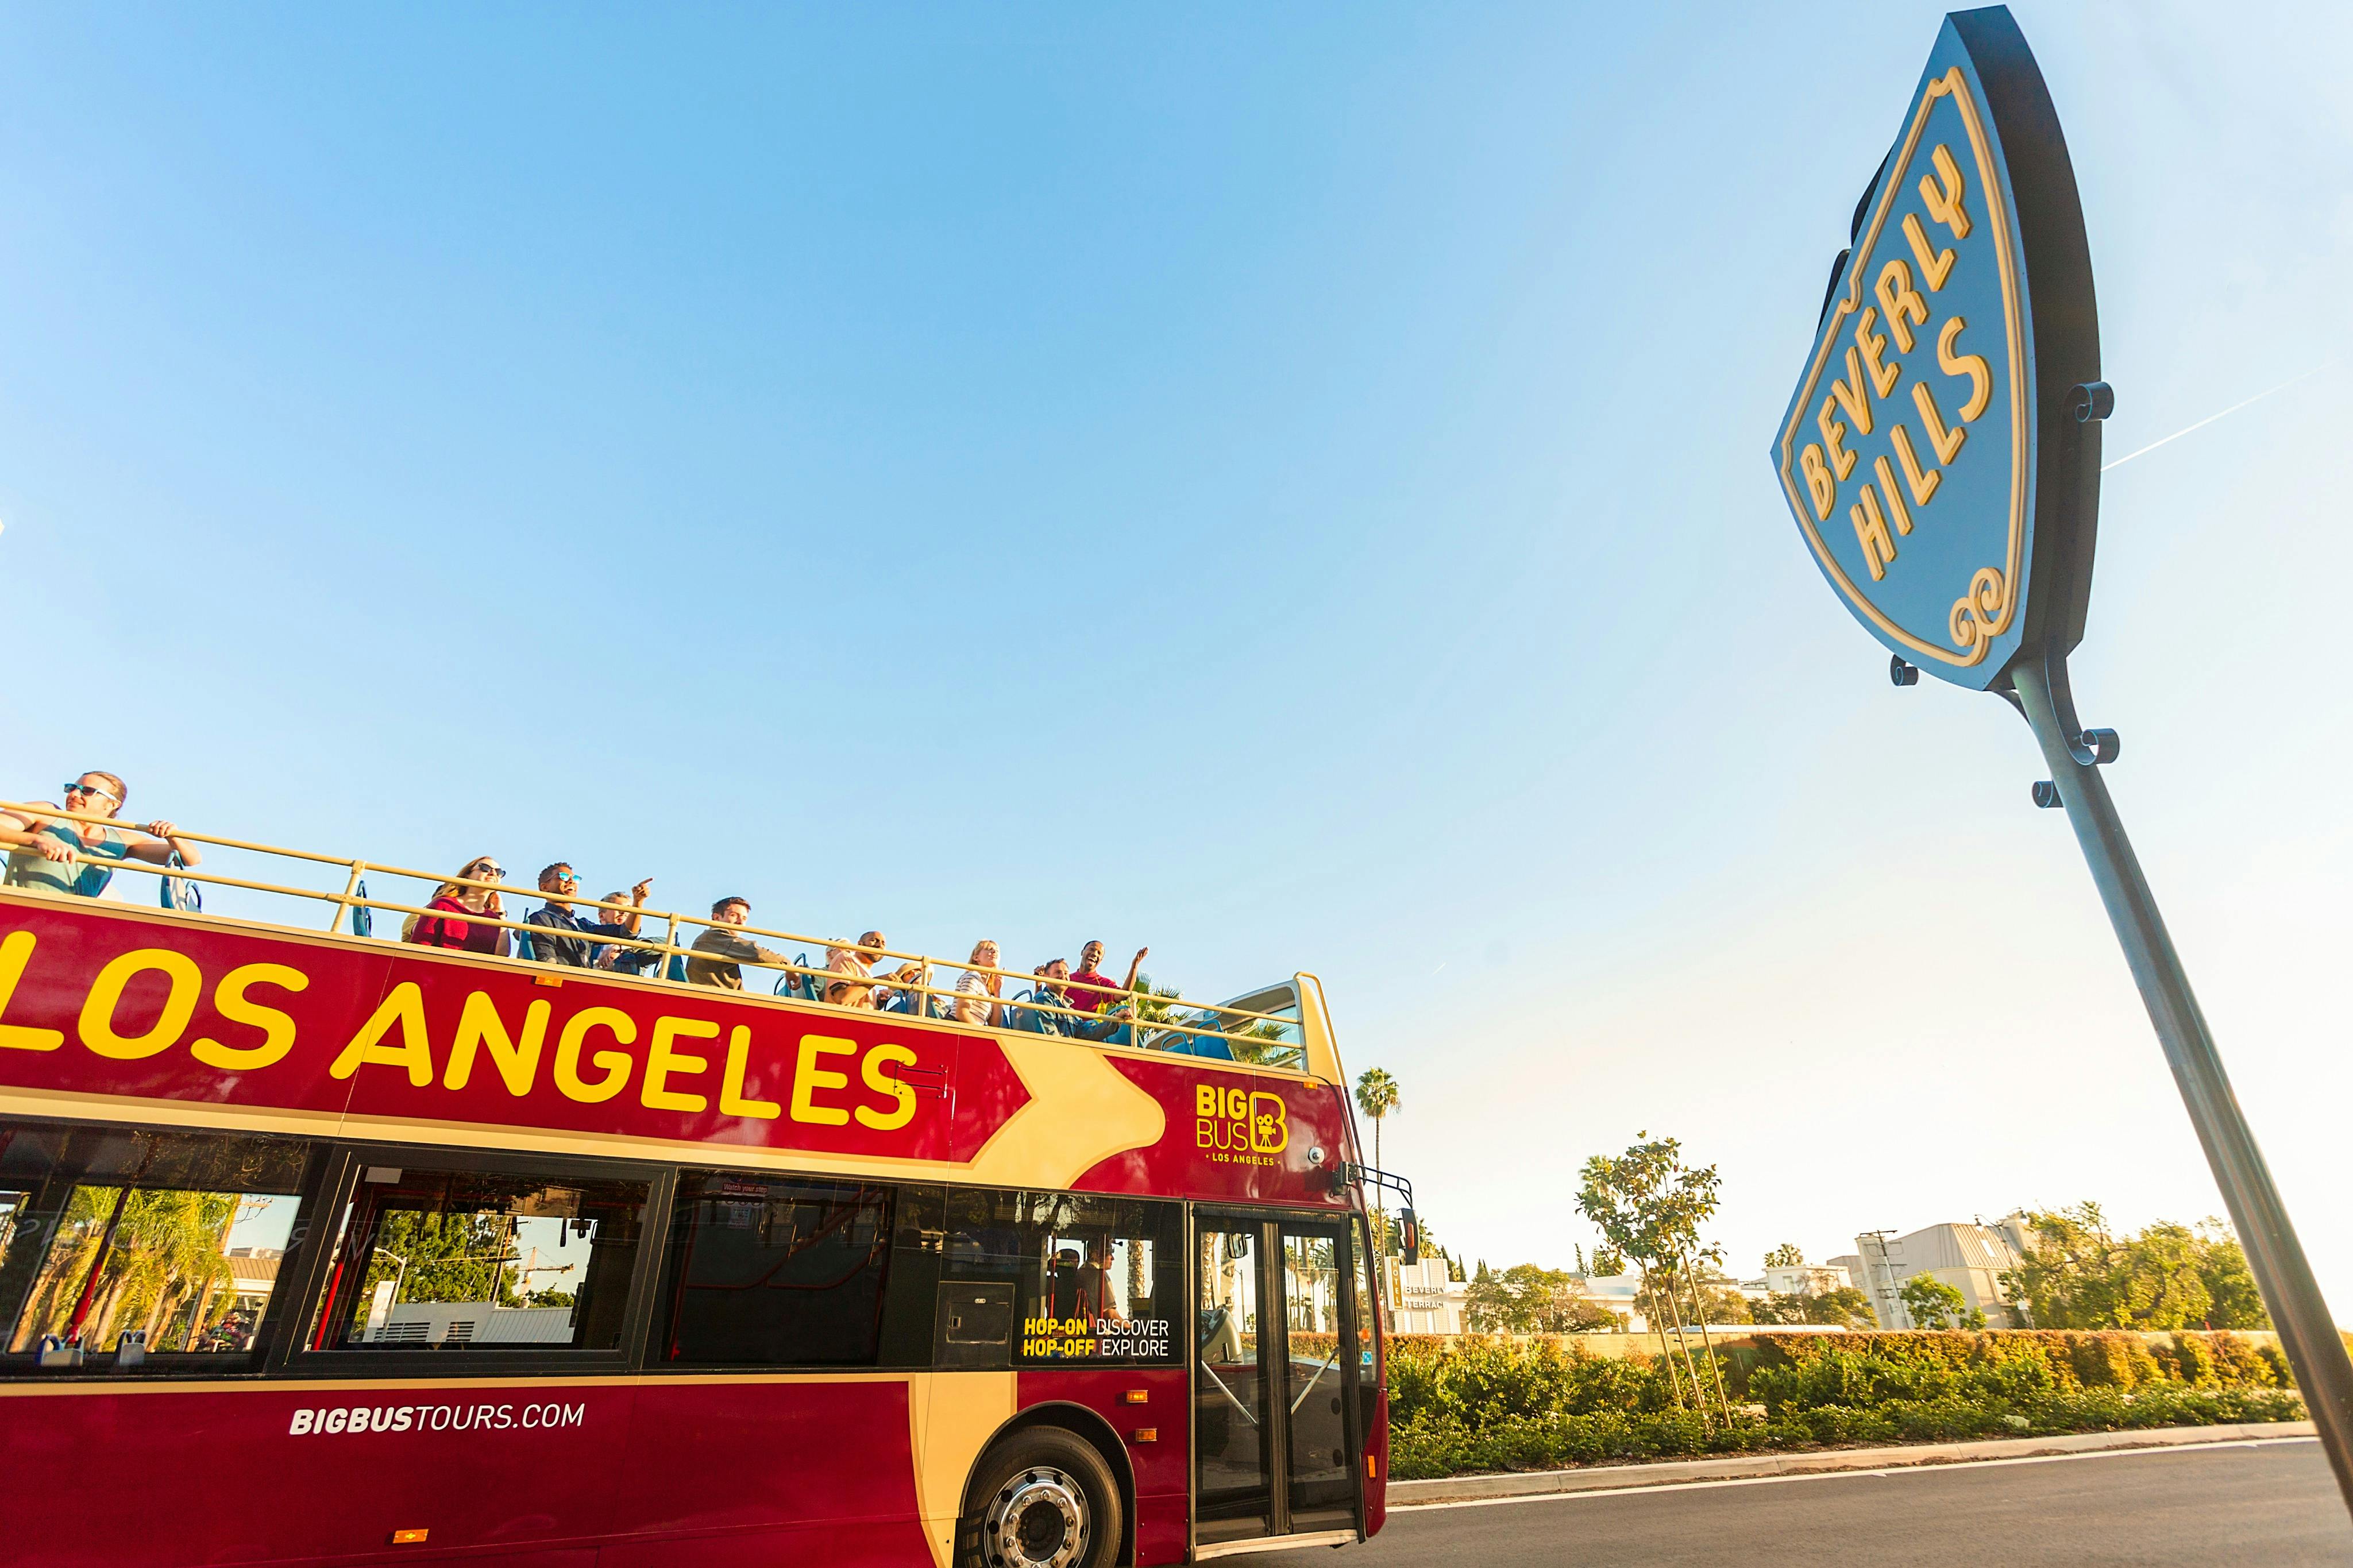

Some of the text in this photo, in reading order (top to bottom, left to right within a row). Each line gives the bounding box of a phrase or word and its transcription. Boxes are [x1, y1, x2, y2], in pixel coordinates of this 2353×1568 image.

[1800, 143, 1974, 521] BEVERLY
[1850, 316, 1993, 581] HILLS
[0, 930, 917, 1130] LOS ANGELES
[1197, 1084, 1247, 1120] BIG
[1197, 1118, 1248, 1151] BUS
[1213, 1153, 1274, 1166] LOS ANGELES
[1024, 1318, 1168, 1336] HOP-ON DISCOVER
[1023, 1339, 1168, 1356] HOP-OFF EXPLORE
[289, 1403, 585, 1435] BIGBUSTOURS.COM
